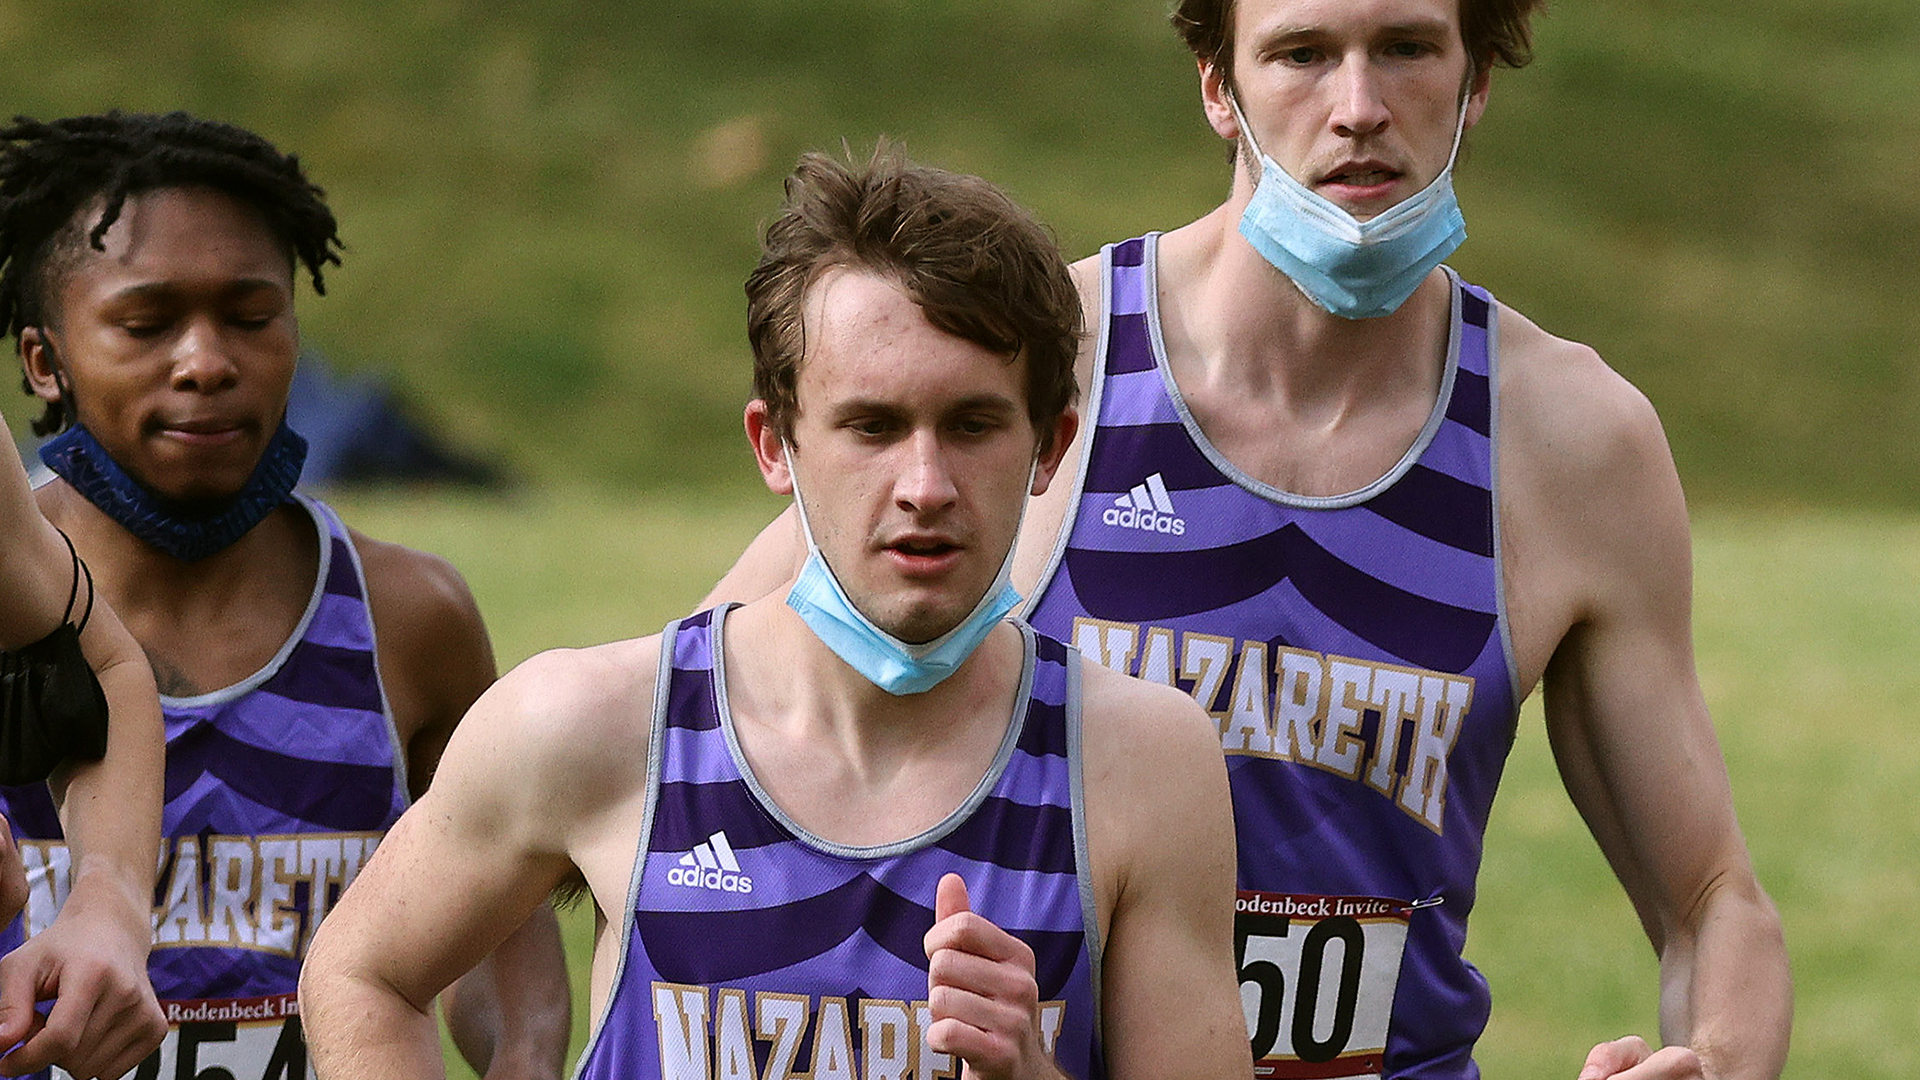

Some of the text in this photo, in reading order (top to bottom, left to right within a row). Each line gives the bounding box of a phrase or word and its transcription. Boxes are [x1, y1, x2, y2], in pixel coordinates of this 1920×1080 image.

[1102, 506, 1186, 536] adidas
[17, 830, 385, 958] NARET
[667, 865, 753, 894] adidas
[1236, 894, 1390, 916] odenbeck Invite
[167, 999, 275, 1021] Rodenbeck
[651, 981, 1066, 1080] NAZAR
